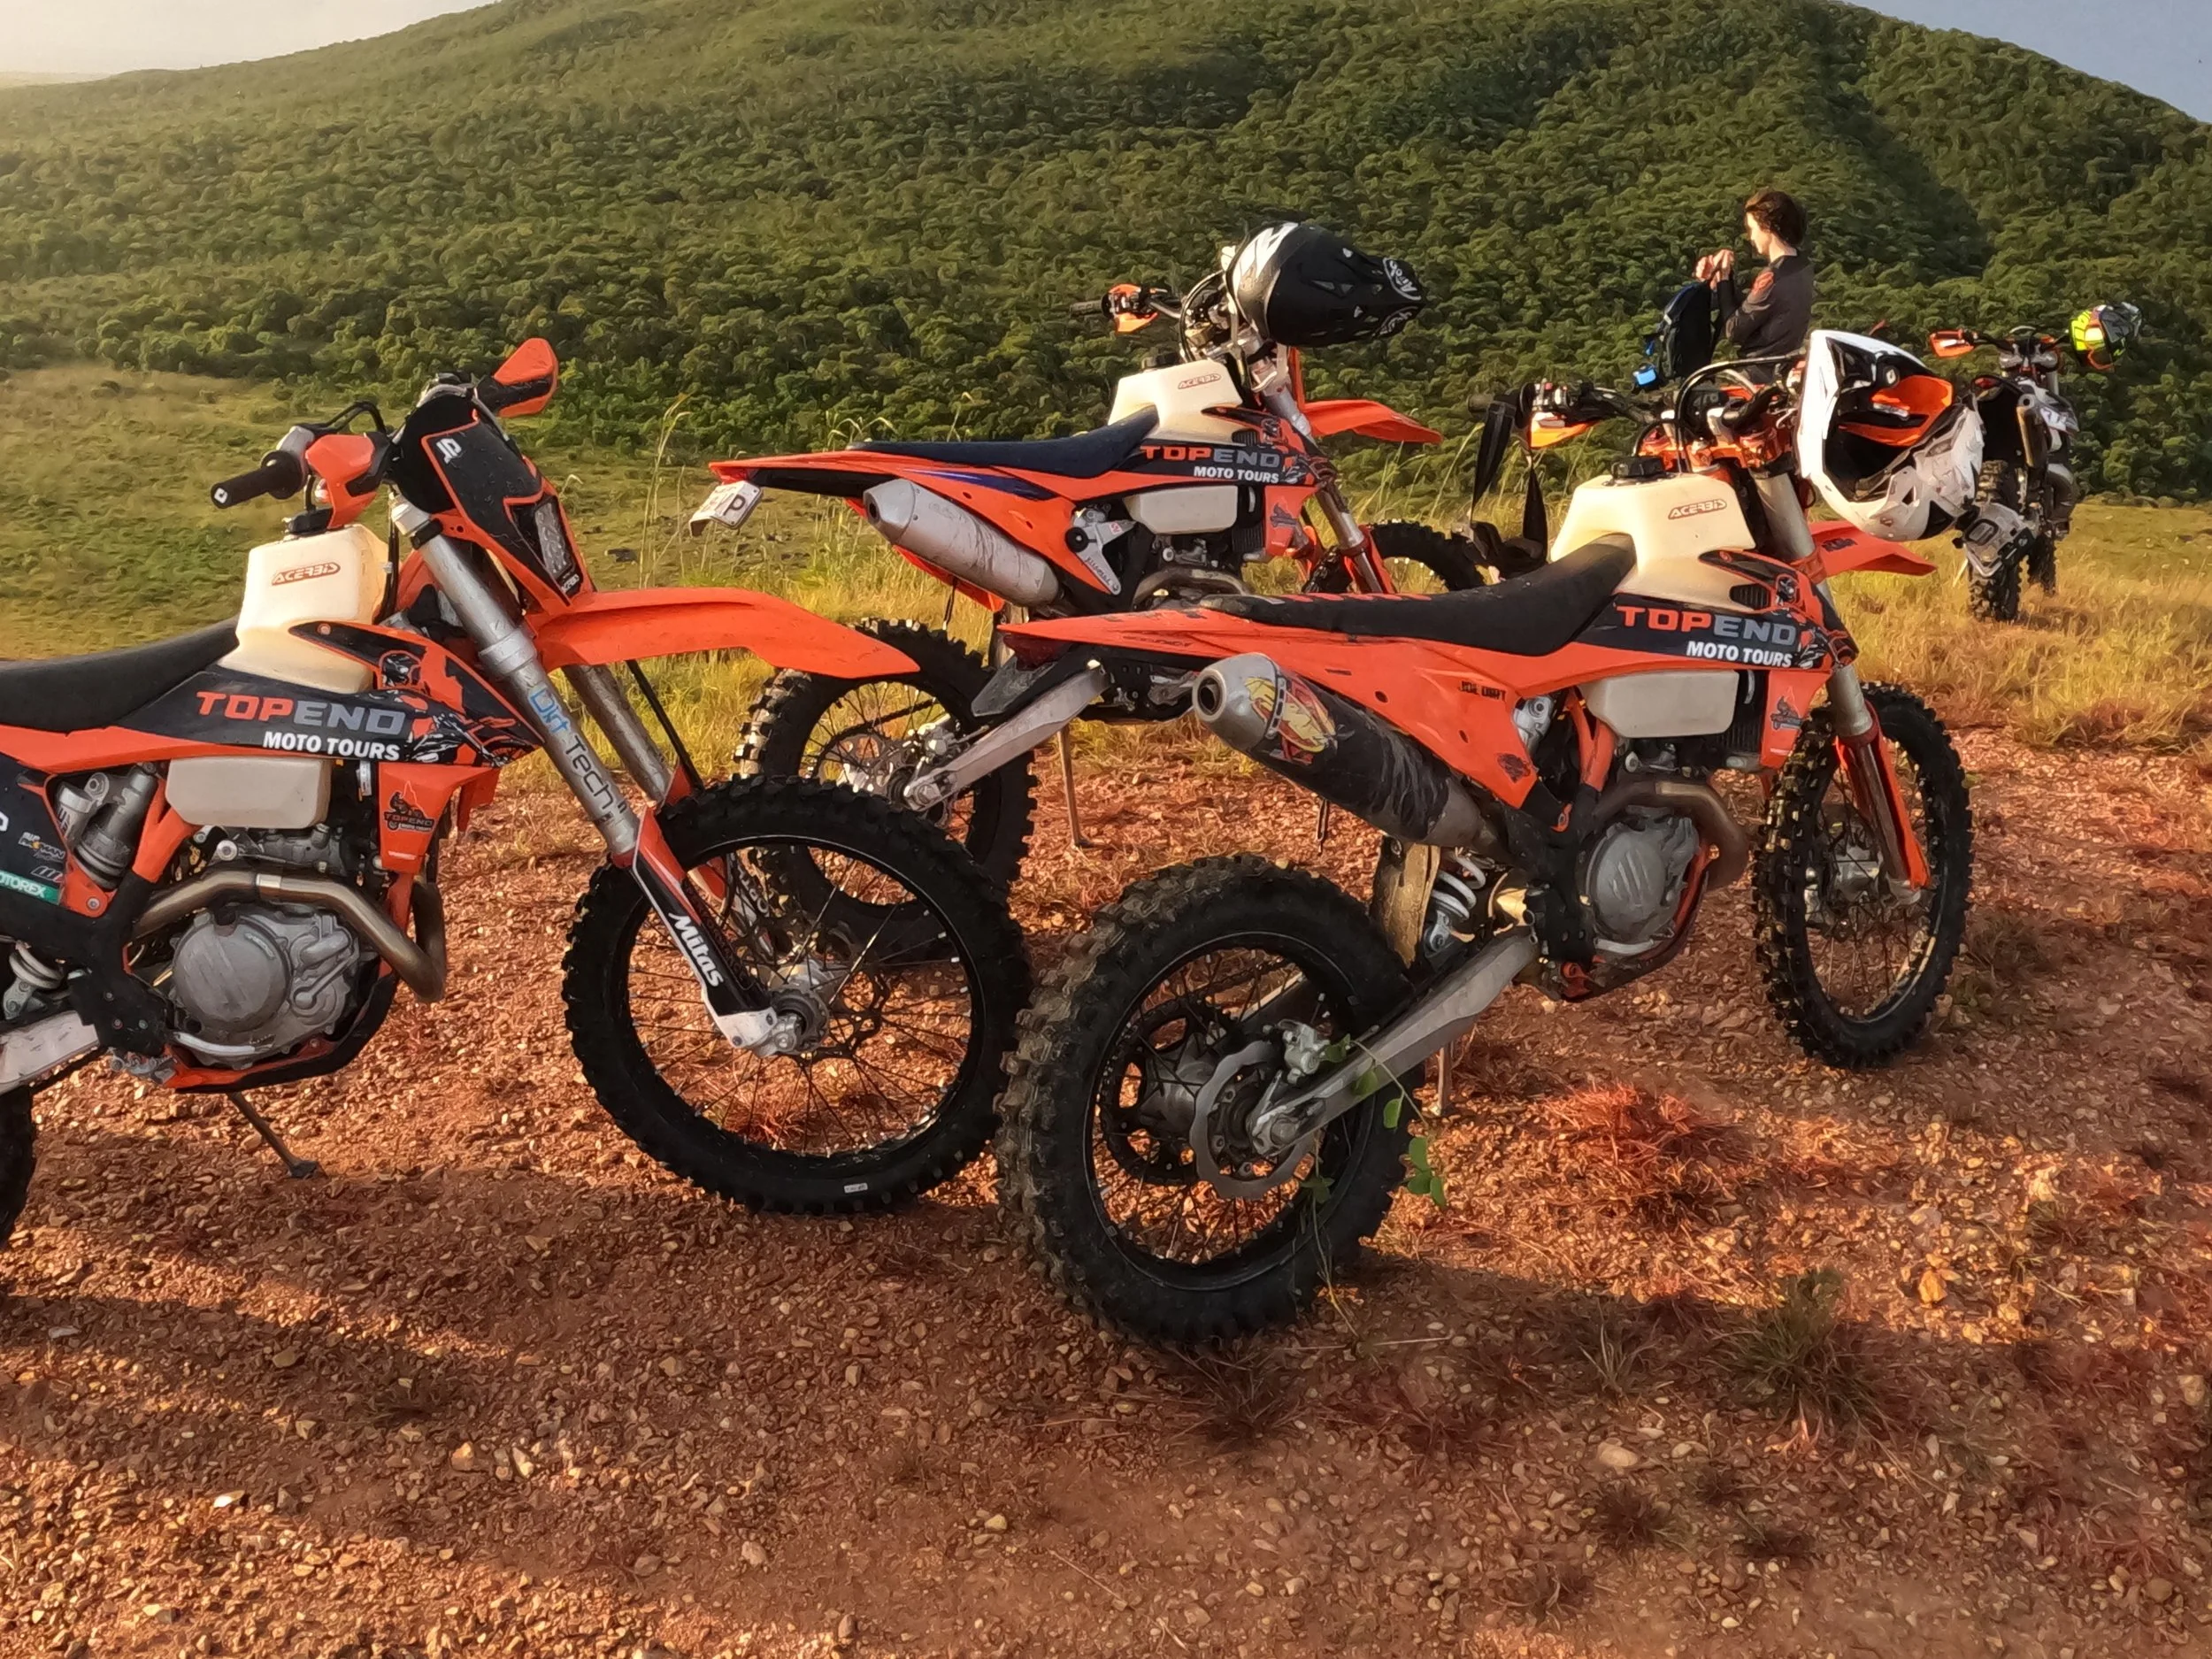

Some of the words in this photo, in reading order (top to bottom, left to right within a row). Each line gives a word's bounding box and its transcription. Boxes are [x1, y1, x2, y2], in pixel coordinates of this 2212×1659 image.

[1194, 465, 1234, 479] MOTO
[1237, 469, 1279, 484] TOURS
[1686, 641, 1740, 661] MOTO
[1742, 649, 1793, 668] TOURS
[263, 731, 322, 752] MOTO
[326, 737, 401, 761] TOURS
[530, 688, 569, 733] Dirt
[565, 735, 614, 810] Tech
[0, 870, 46, 898] OTOREX
[668, 912, 724, 987] Mitas
